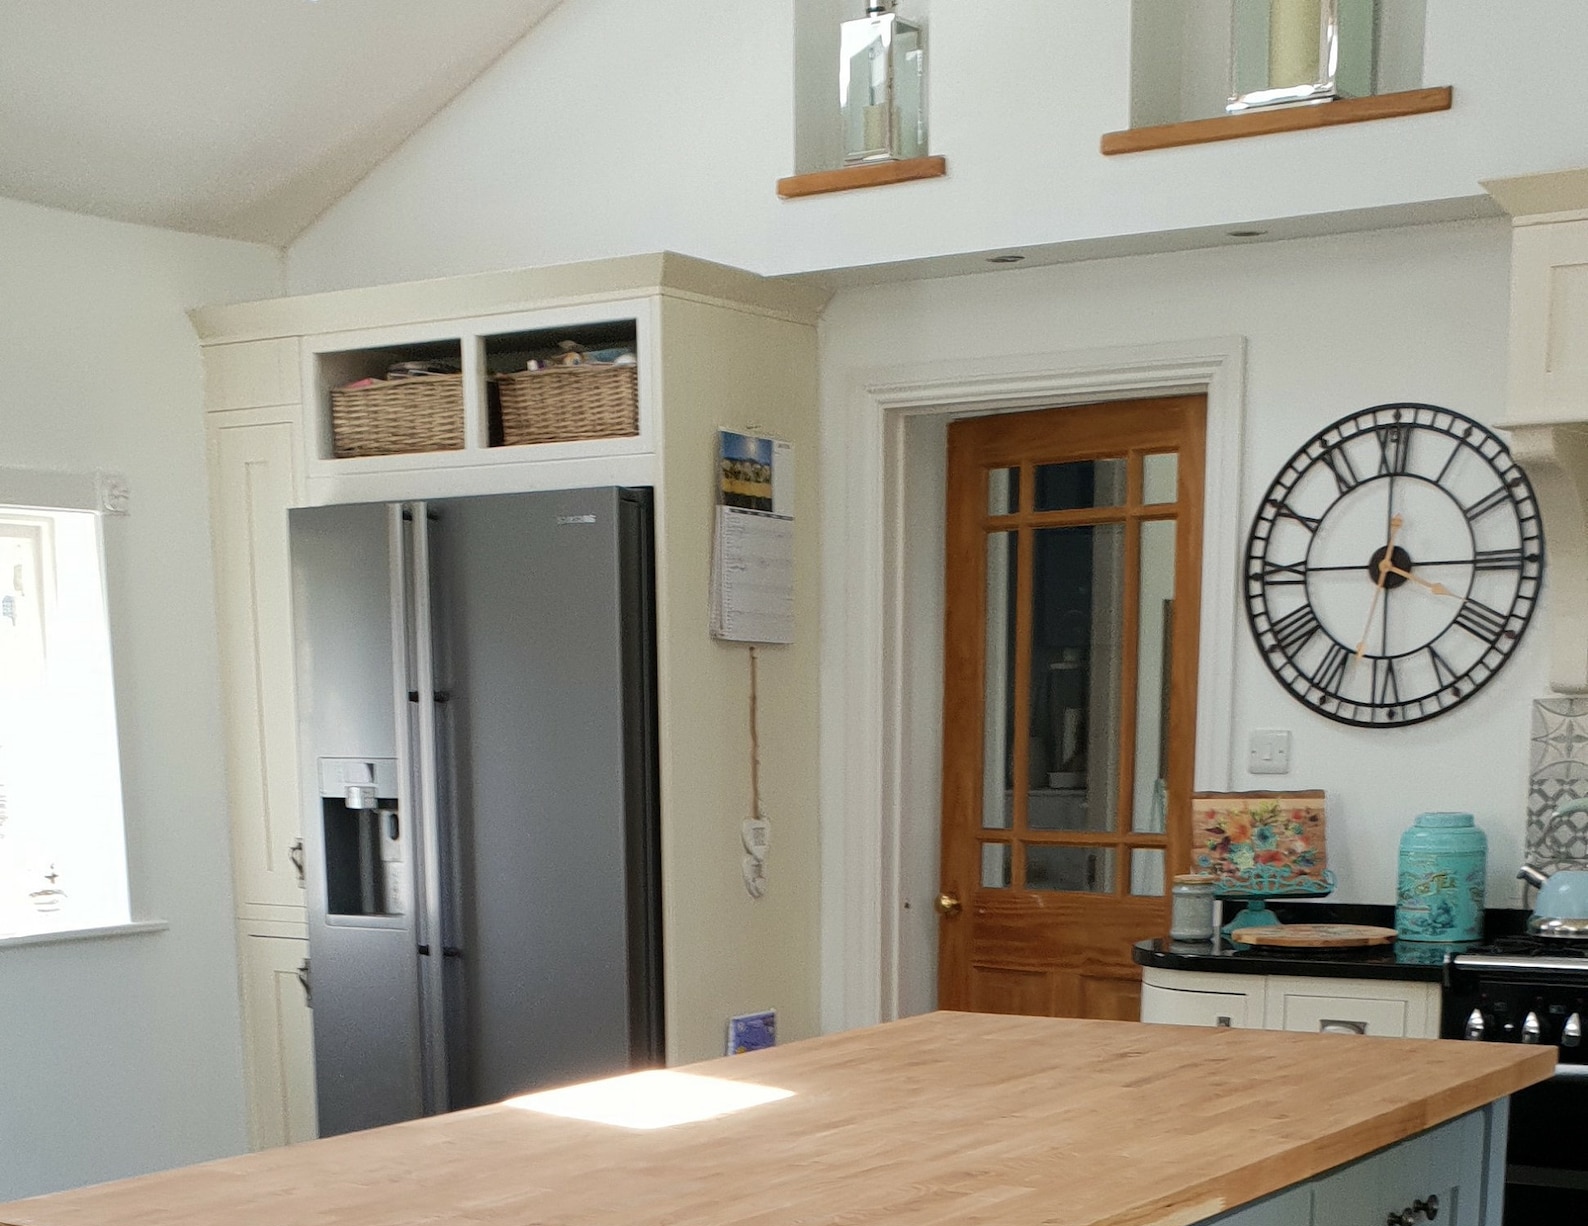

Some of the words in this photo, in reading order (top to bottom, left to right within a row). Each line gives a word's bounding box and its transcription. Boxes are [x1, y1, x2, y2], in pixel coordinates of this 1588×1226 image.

[1319, 446, 1359, 494] XI
[1376, 425, 1412, 474] XII
[1277, 502, 1321, 533] X
[1263, 560, 1306, 587] IX
[1475, 548, 1521, 571] III
[1269, 603, 1321, 659] VIII
[1311, 643, 1350, 695] VII
[1372, 658, 1400, 705] VI
[1426, 646, 1459, 689] V
